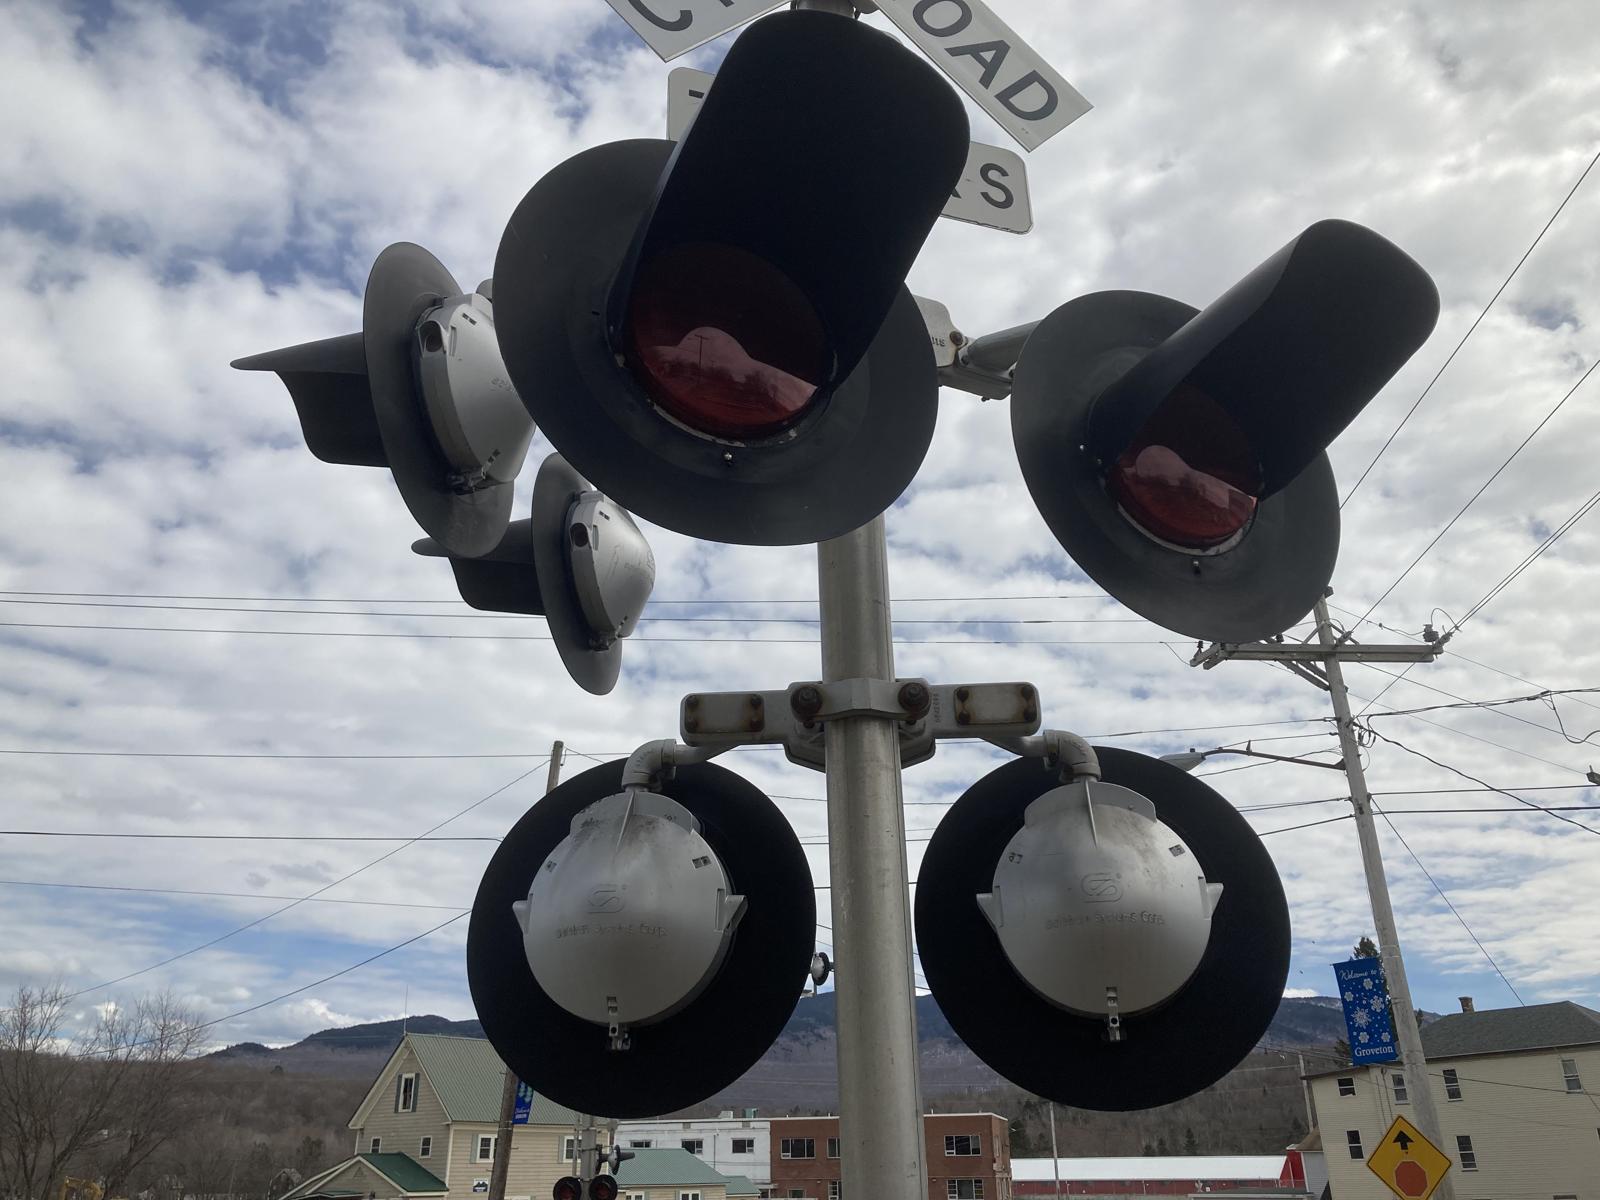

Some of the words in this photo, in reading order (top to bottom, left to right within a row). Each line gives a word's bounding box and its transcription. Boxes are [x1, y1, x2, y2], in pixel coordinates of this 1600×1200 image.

[912, 0, 1059, 121] OAD
[1339, 970, 1369, 980] Welcome
[1355, 1046, 1394, 1057] Groveton
